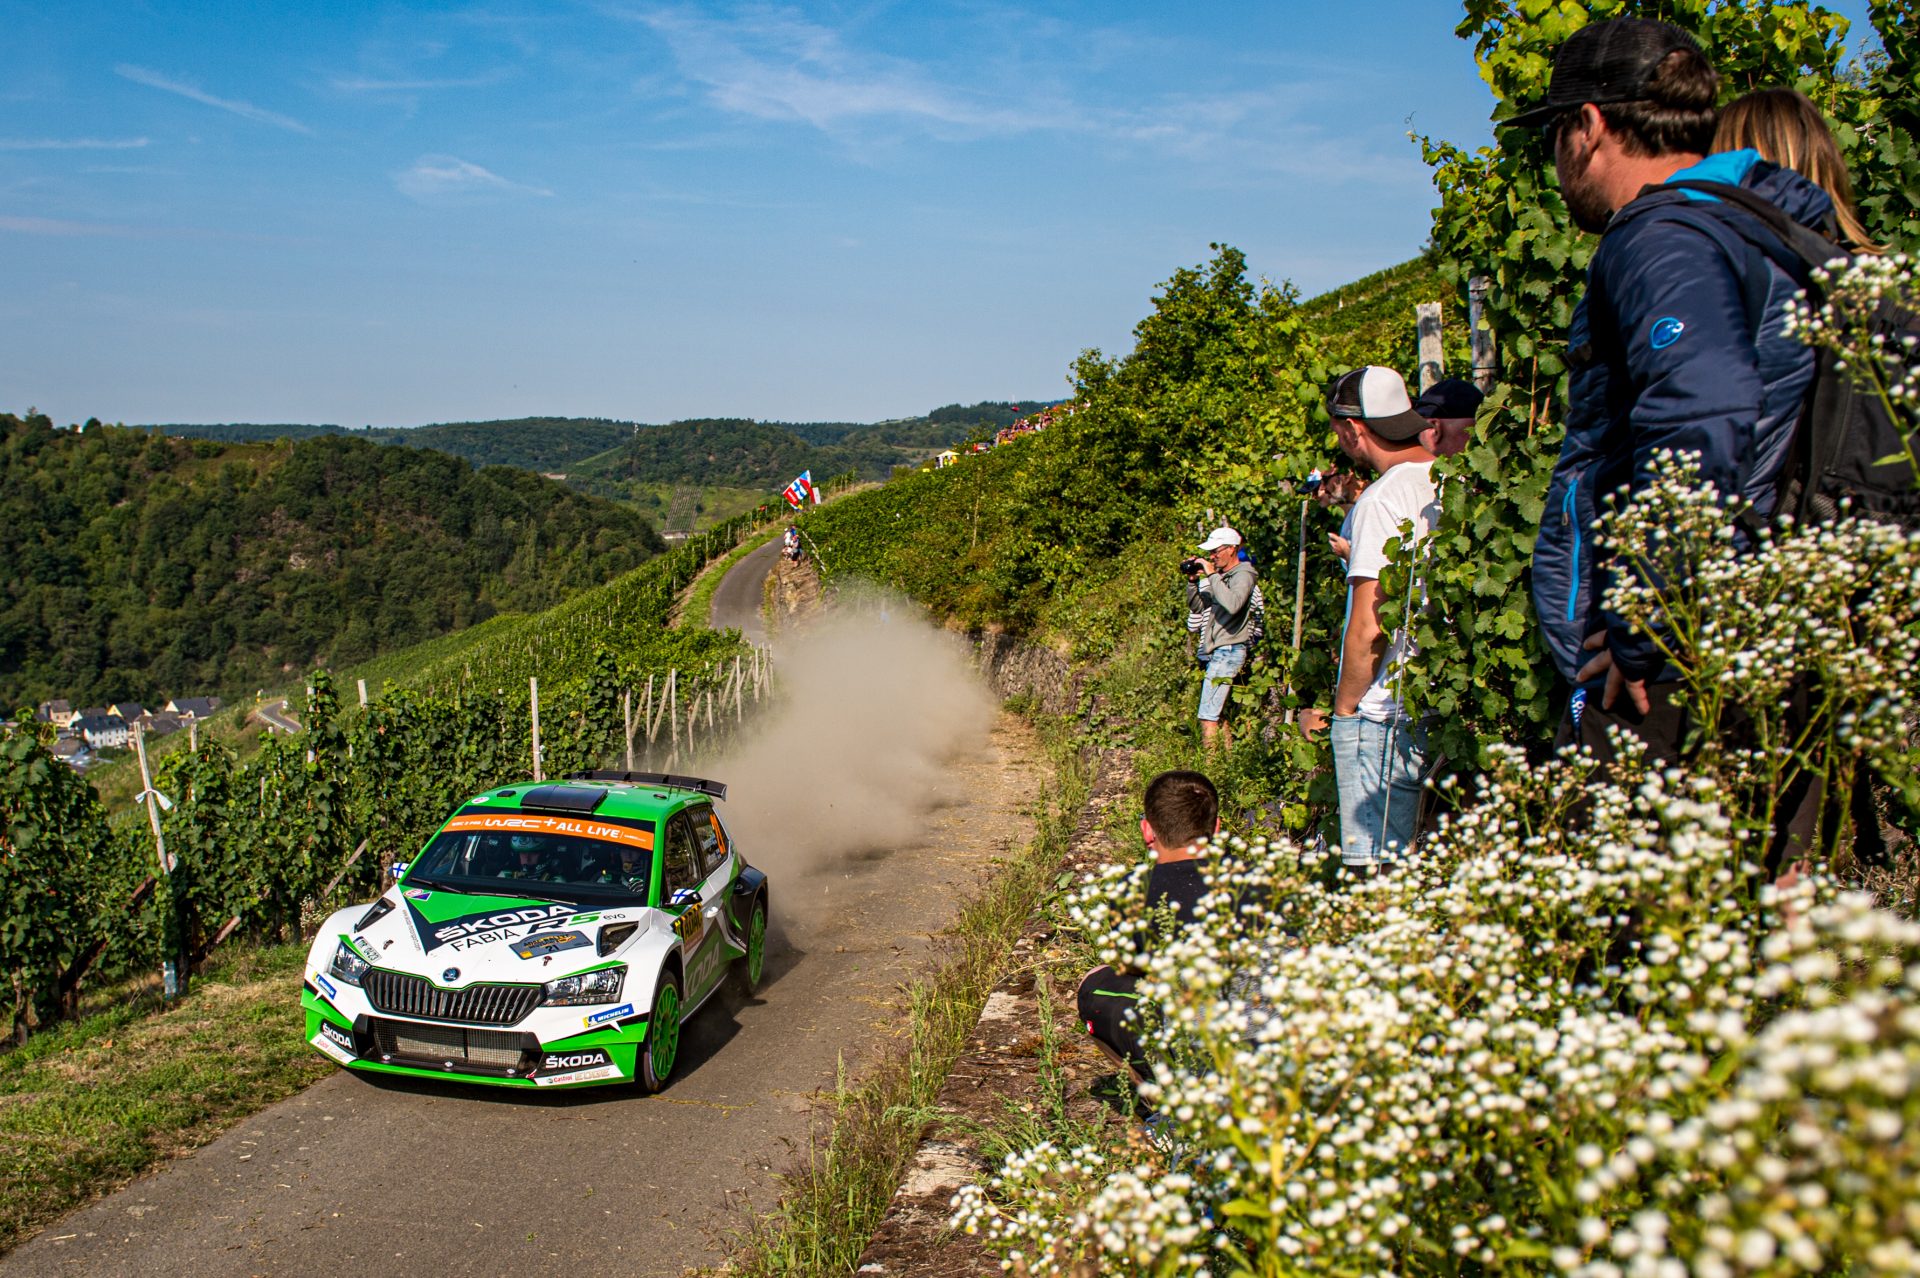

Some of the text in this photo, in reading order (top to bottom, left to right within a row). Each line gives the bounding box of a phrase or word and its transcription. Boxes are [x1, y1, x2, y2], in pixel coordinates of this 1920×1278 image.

[556, 823, 582, 834] ALL
[588, 827, 619, 839] LIVE
[435, 905, 578, 942] ŠKODA
[450, 929, 521, 952] FABIA
[546, 944, 560, 953] 21
[597, 1007, 630, 1022] MICHELIN
[322, 1022, 353, 1049] ŠKODA
[545, 1053, 605, 1069] ŠKODA
